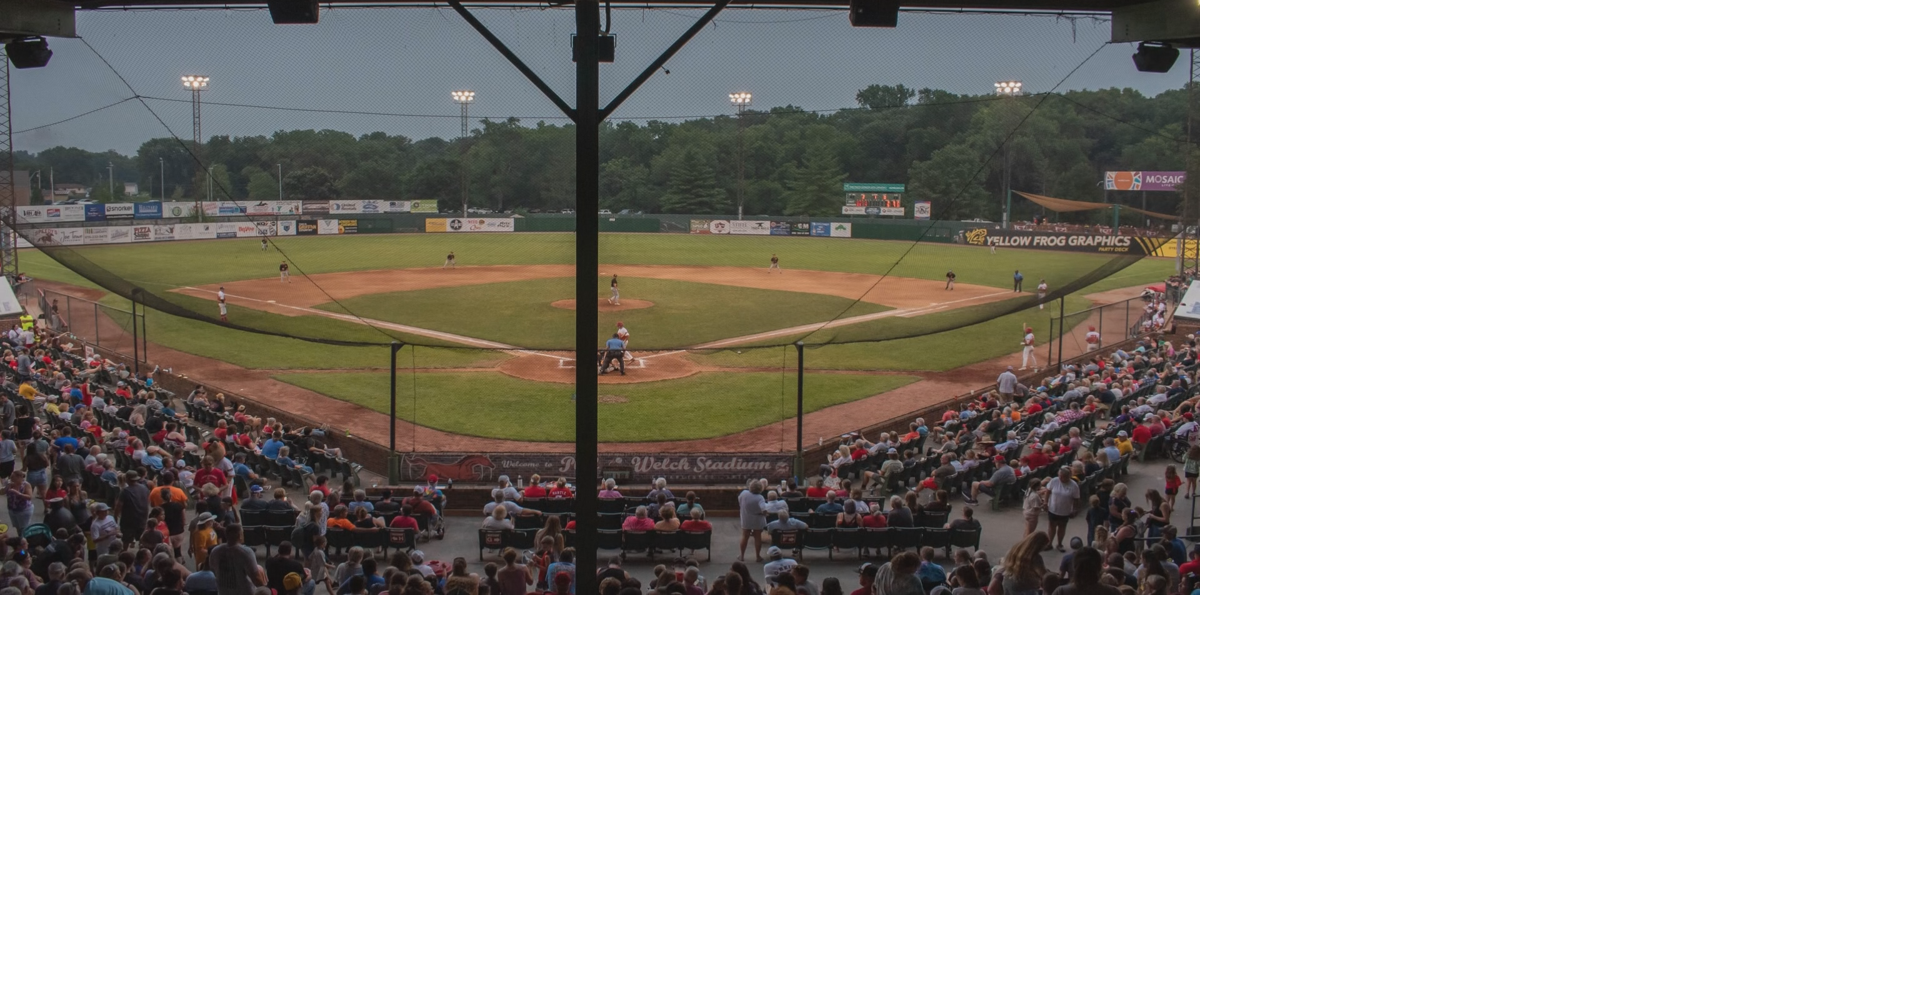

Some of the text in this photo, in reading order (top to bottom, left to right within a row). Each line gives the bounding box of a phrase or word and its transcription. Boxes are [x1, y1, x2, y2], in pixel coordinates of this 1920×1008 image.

[1146, 175, 1183, 184] MOSAIC
[987, 235, 1131, 247] YELLOW FROG GRAPHICS
[501, 459, 540, 468] Welcome
[545, 459, 553, 468] to
[631, 456, 691, 473] Welch
[693, 457, 772, 473] Stadium
